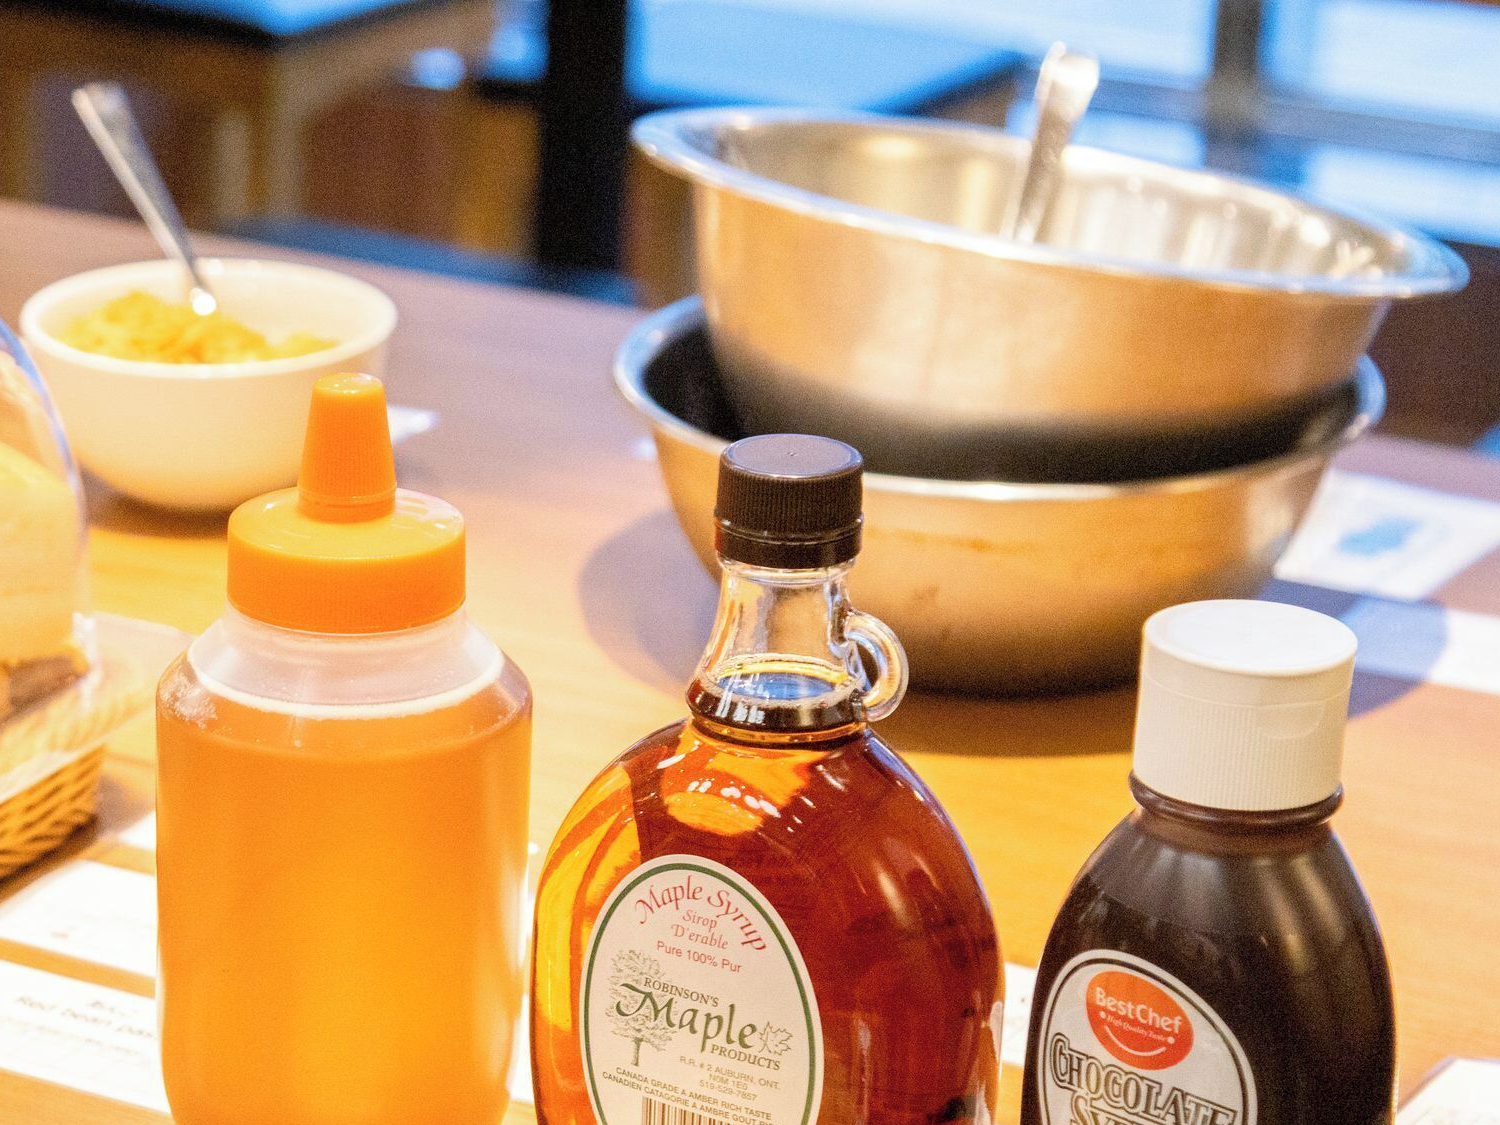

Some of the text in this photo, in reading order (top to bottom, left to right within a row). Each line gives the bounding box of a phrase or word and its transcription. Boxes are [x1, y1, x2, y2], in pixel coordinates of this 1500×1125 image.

[635, 875, 767, 951] Maple Syrup
[682, 909, 717, 931] Sirop
[670, 923, 728, 949] D'erable
[657, 940, 742, 973] Pure 100% Pur
[644, 977, 720, 1008] ROBINSON'S
[615, 983, 757, 1053] Maple
[1106, 1014, 1122, 1027] High
[1123, 1022, 1148, 1037] Quality
[710, 1043, 781, 1071] PRODUCTS
[602, 1071, 642, 1092] CANADIEN
[699, 1104, 730, 1120] AMBRE
[616, 1066, 649, 1085] CANADA
[651, 1079, 679, 1095] GRADE
[689, 1091, 719, 1107] AMBER
[721, 1101, 743, 1113] RICH
[744, 1107, 772, 1121] TASTE
